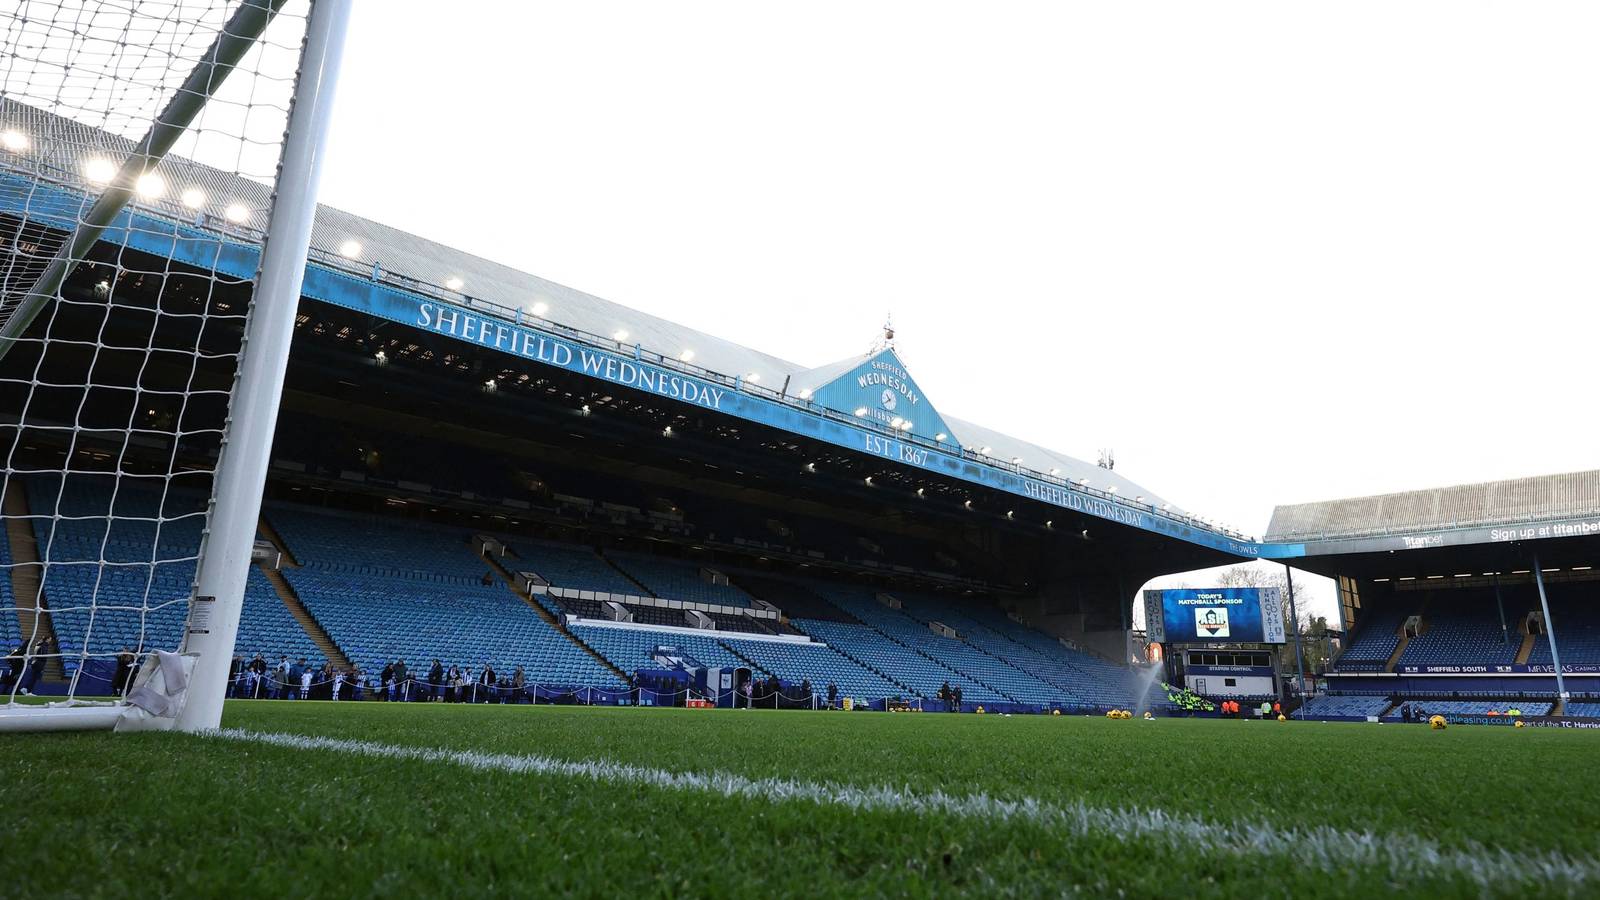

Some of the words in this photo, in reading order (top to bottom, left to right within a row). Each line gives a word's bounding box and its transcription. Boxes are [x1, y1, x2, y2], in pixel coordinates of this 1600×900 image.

[417, 303, 572, 366] SHEFFIELD
[580, 350, 724, 409] WEDNESDAY
[871, 361, 907, 380] SHEFFIELD
[858, 372, 919, 405] WEDNESDAY
[865, 433, 893, 457] EST.
[898, 444, 928, 466] 1867
[1024, 480, 1082, 510] SHEFFIELD
[1083, 497, 1142, 527] WEDNESDAY
[1490, 529, 1516, 540] Sign
[1519, 528, 1535, 539] up
[1539, 525, 1550, 535] at
[1402, 534, 1443, 547] Titanbet
[1238, 545, 1258, 554] OWLS
[1542, 664, 1573, 673] VEAS
[1446, 714, 1516, 726] chleasing.co.uk
[1537, 720, 1546, 728] of
[1546, 720, 1560, 728] the
[1574, 721, 1600, 729] Harris
